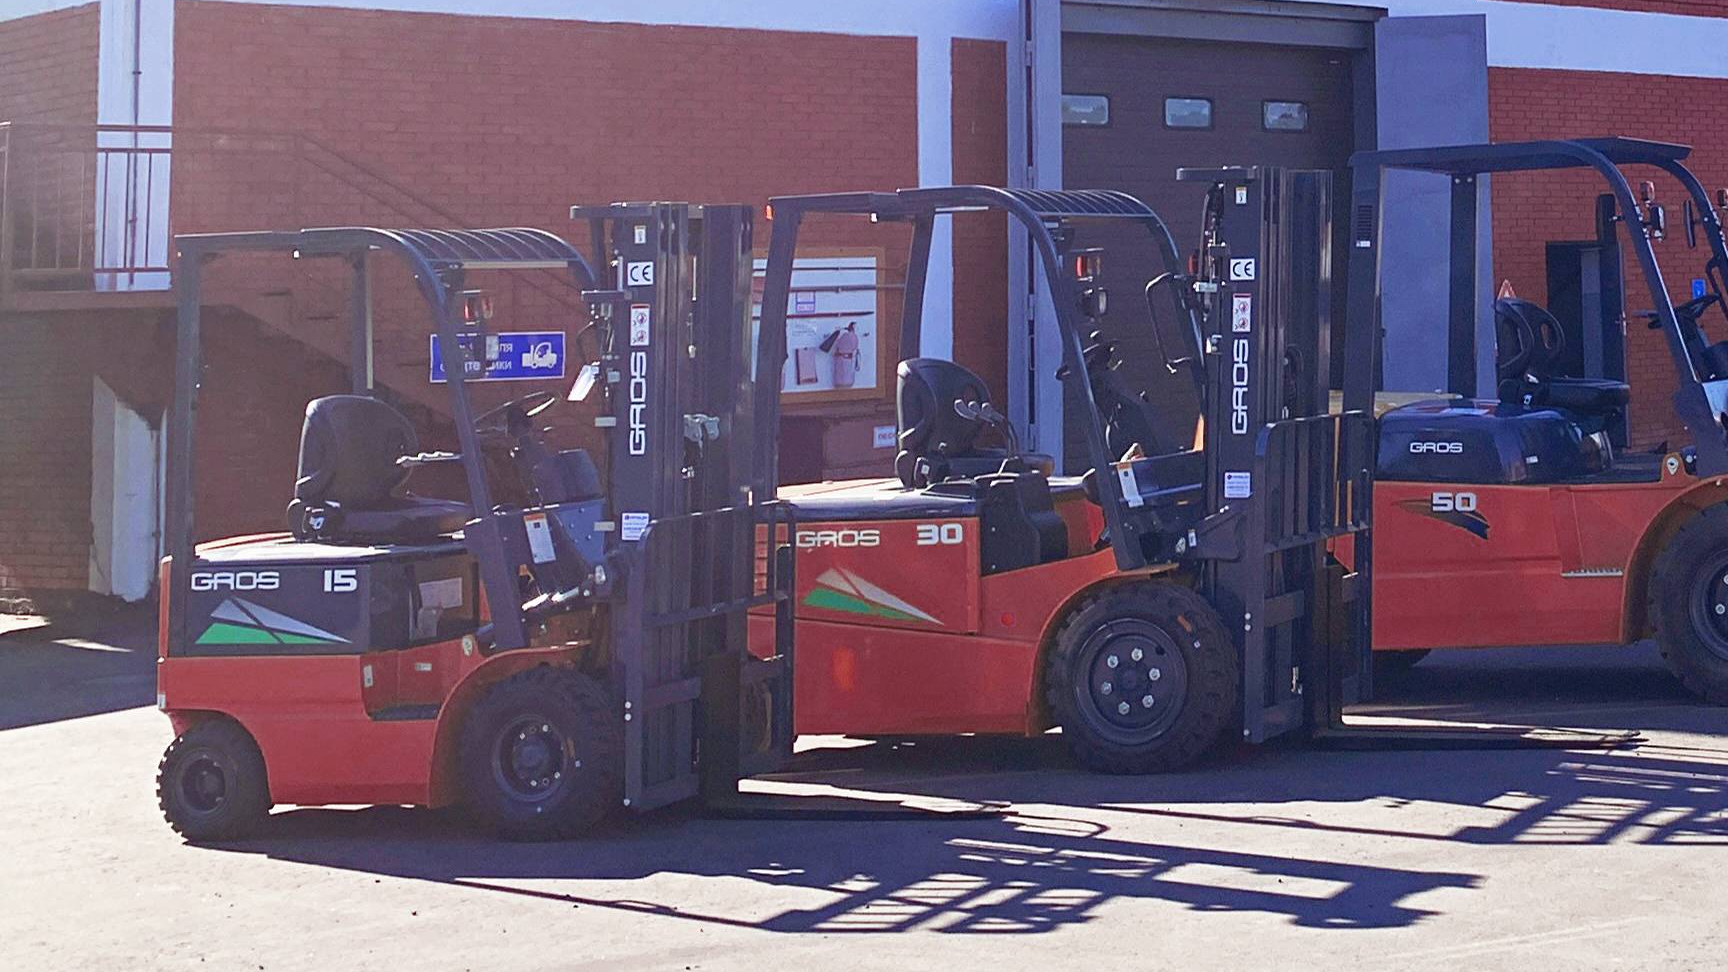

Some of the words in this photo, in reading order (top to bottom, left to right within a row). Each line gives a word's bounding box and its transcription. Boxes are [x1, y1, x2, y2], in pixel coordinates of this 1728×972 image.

[1232, 338, 1249, 435] GROS
[629, 351, 647, 456] GROS
[1409, 441, 1463, 454] GROS
[1432, 492, 1477, 512] 50
[796, 529, 881, 548] GROS
[916, 522, 963, 546] 30
[190, 571, 280, 591] GROS
[324, 569, 358, 593] 15
